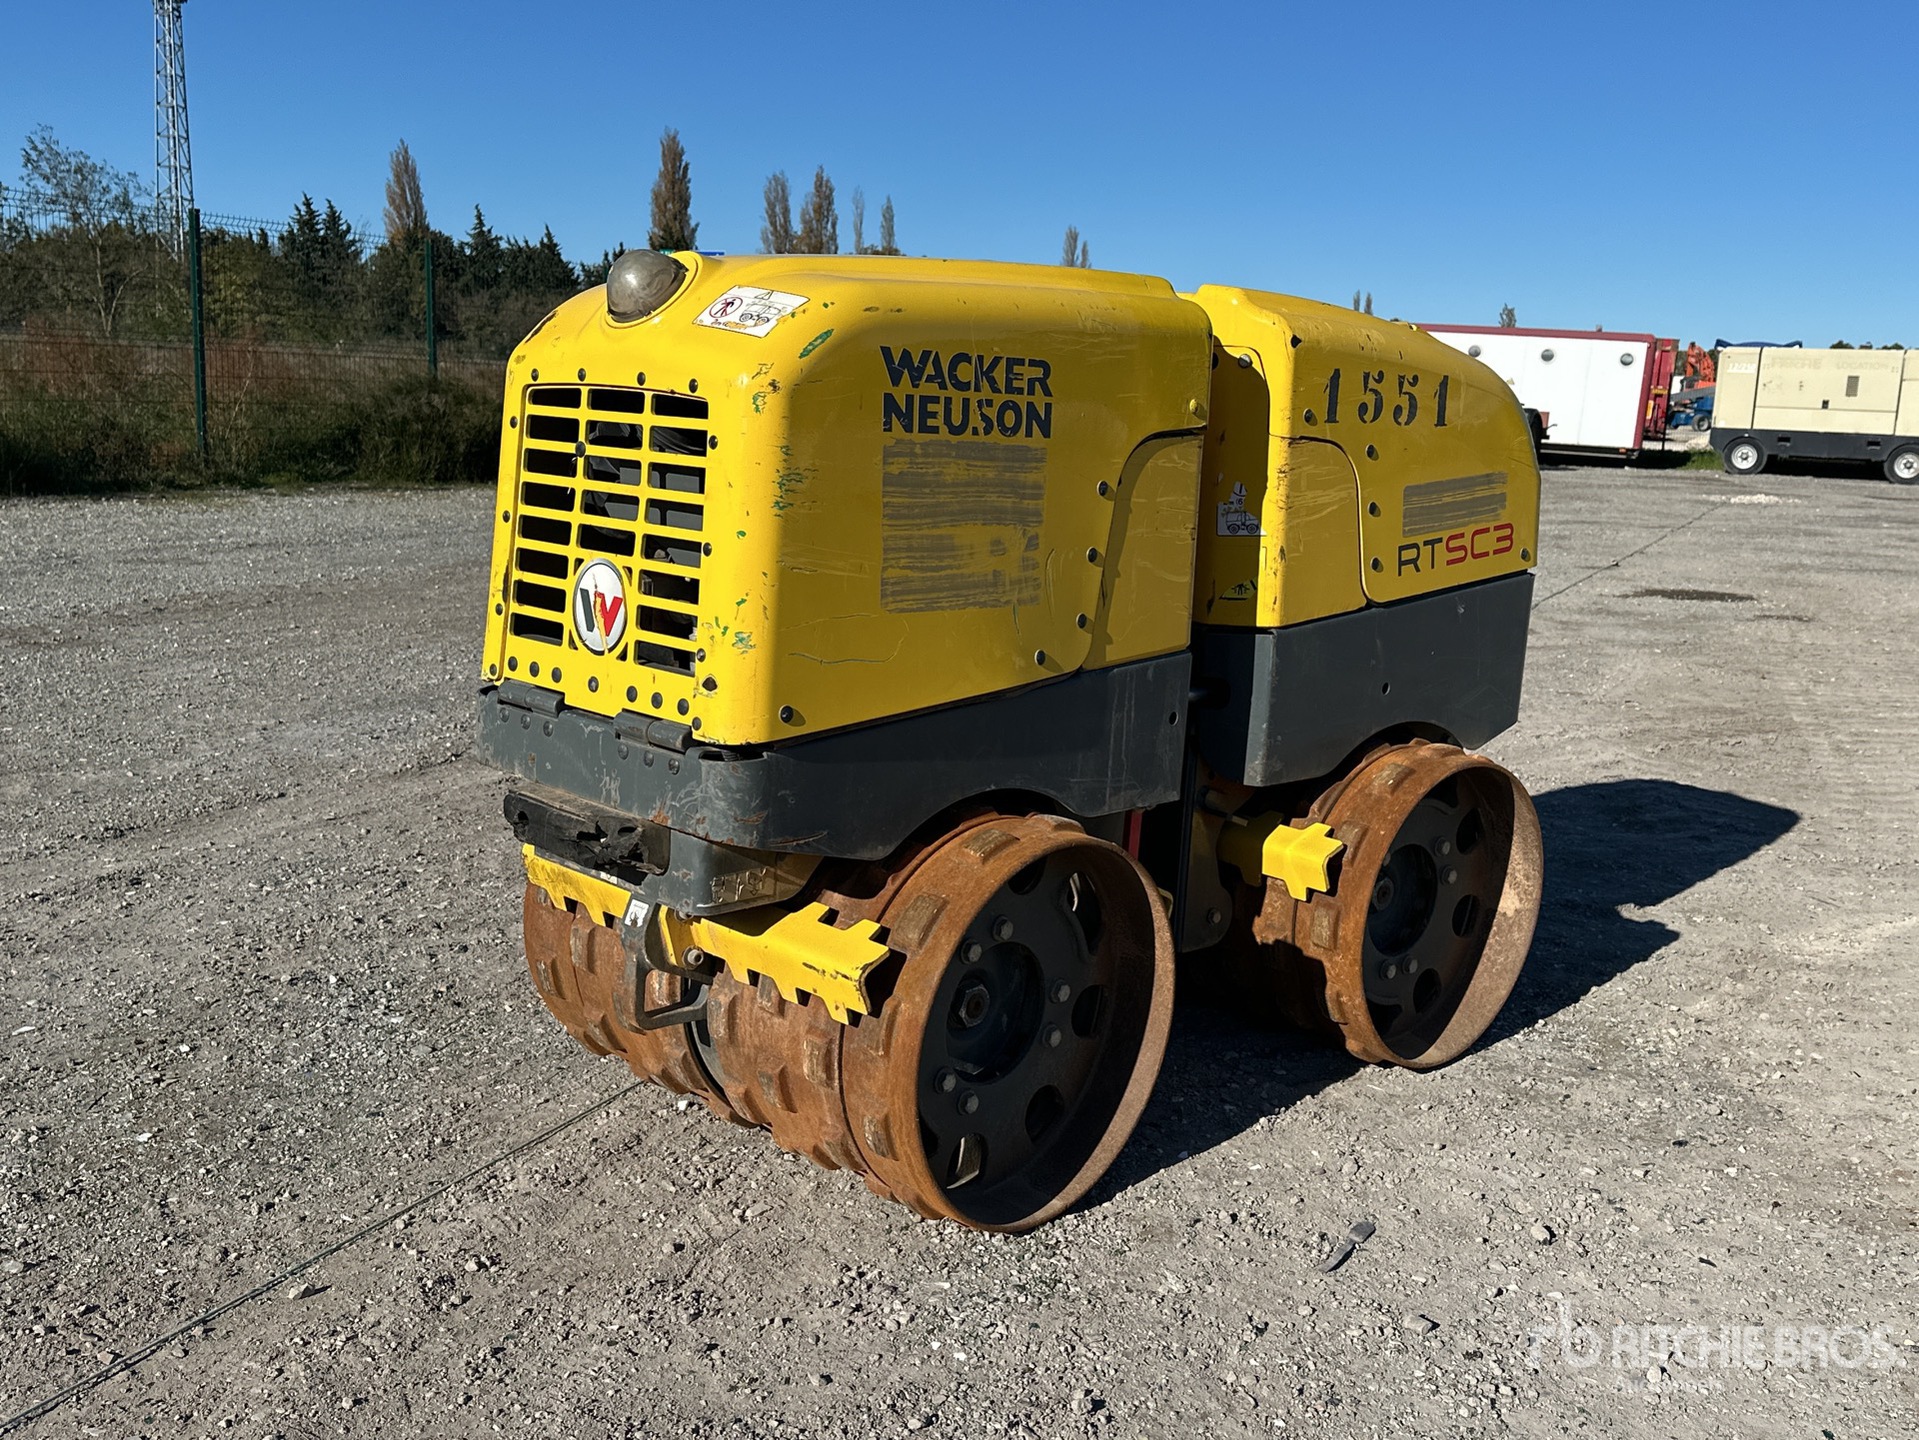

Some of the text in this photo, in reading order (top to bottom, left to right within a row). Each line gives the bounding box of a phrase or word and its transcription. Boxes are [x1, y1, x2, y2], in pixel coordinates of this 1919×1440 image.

[879, 345, 1053, 397] WACKER
[1323, 368, 1449, 427] 1551
[882, 392, 1053, 439] NEUSON
[1397, 523, 1514, 577] RTSC3
